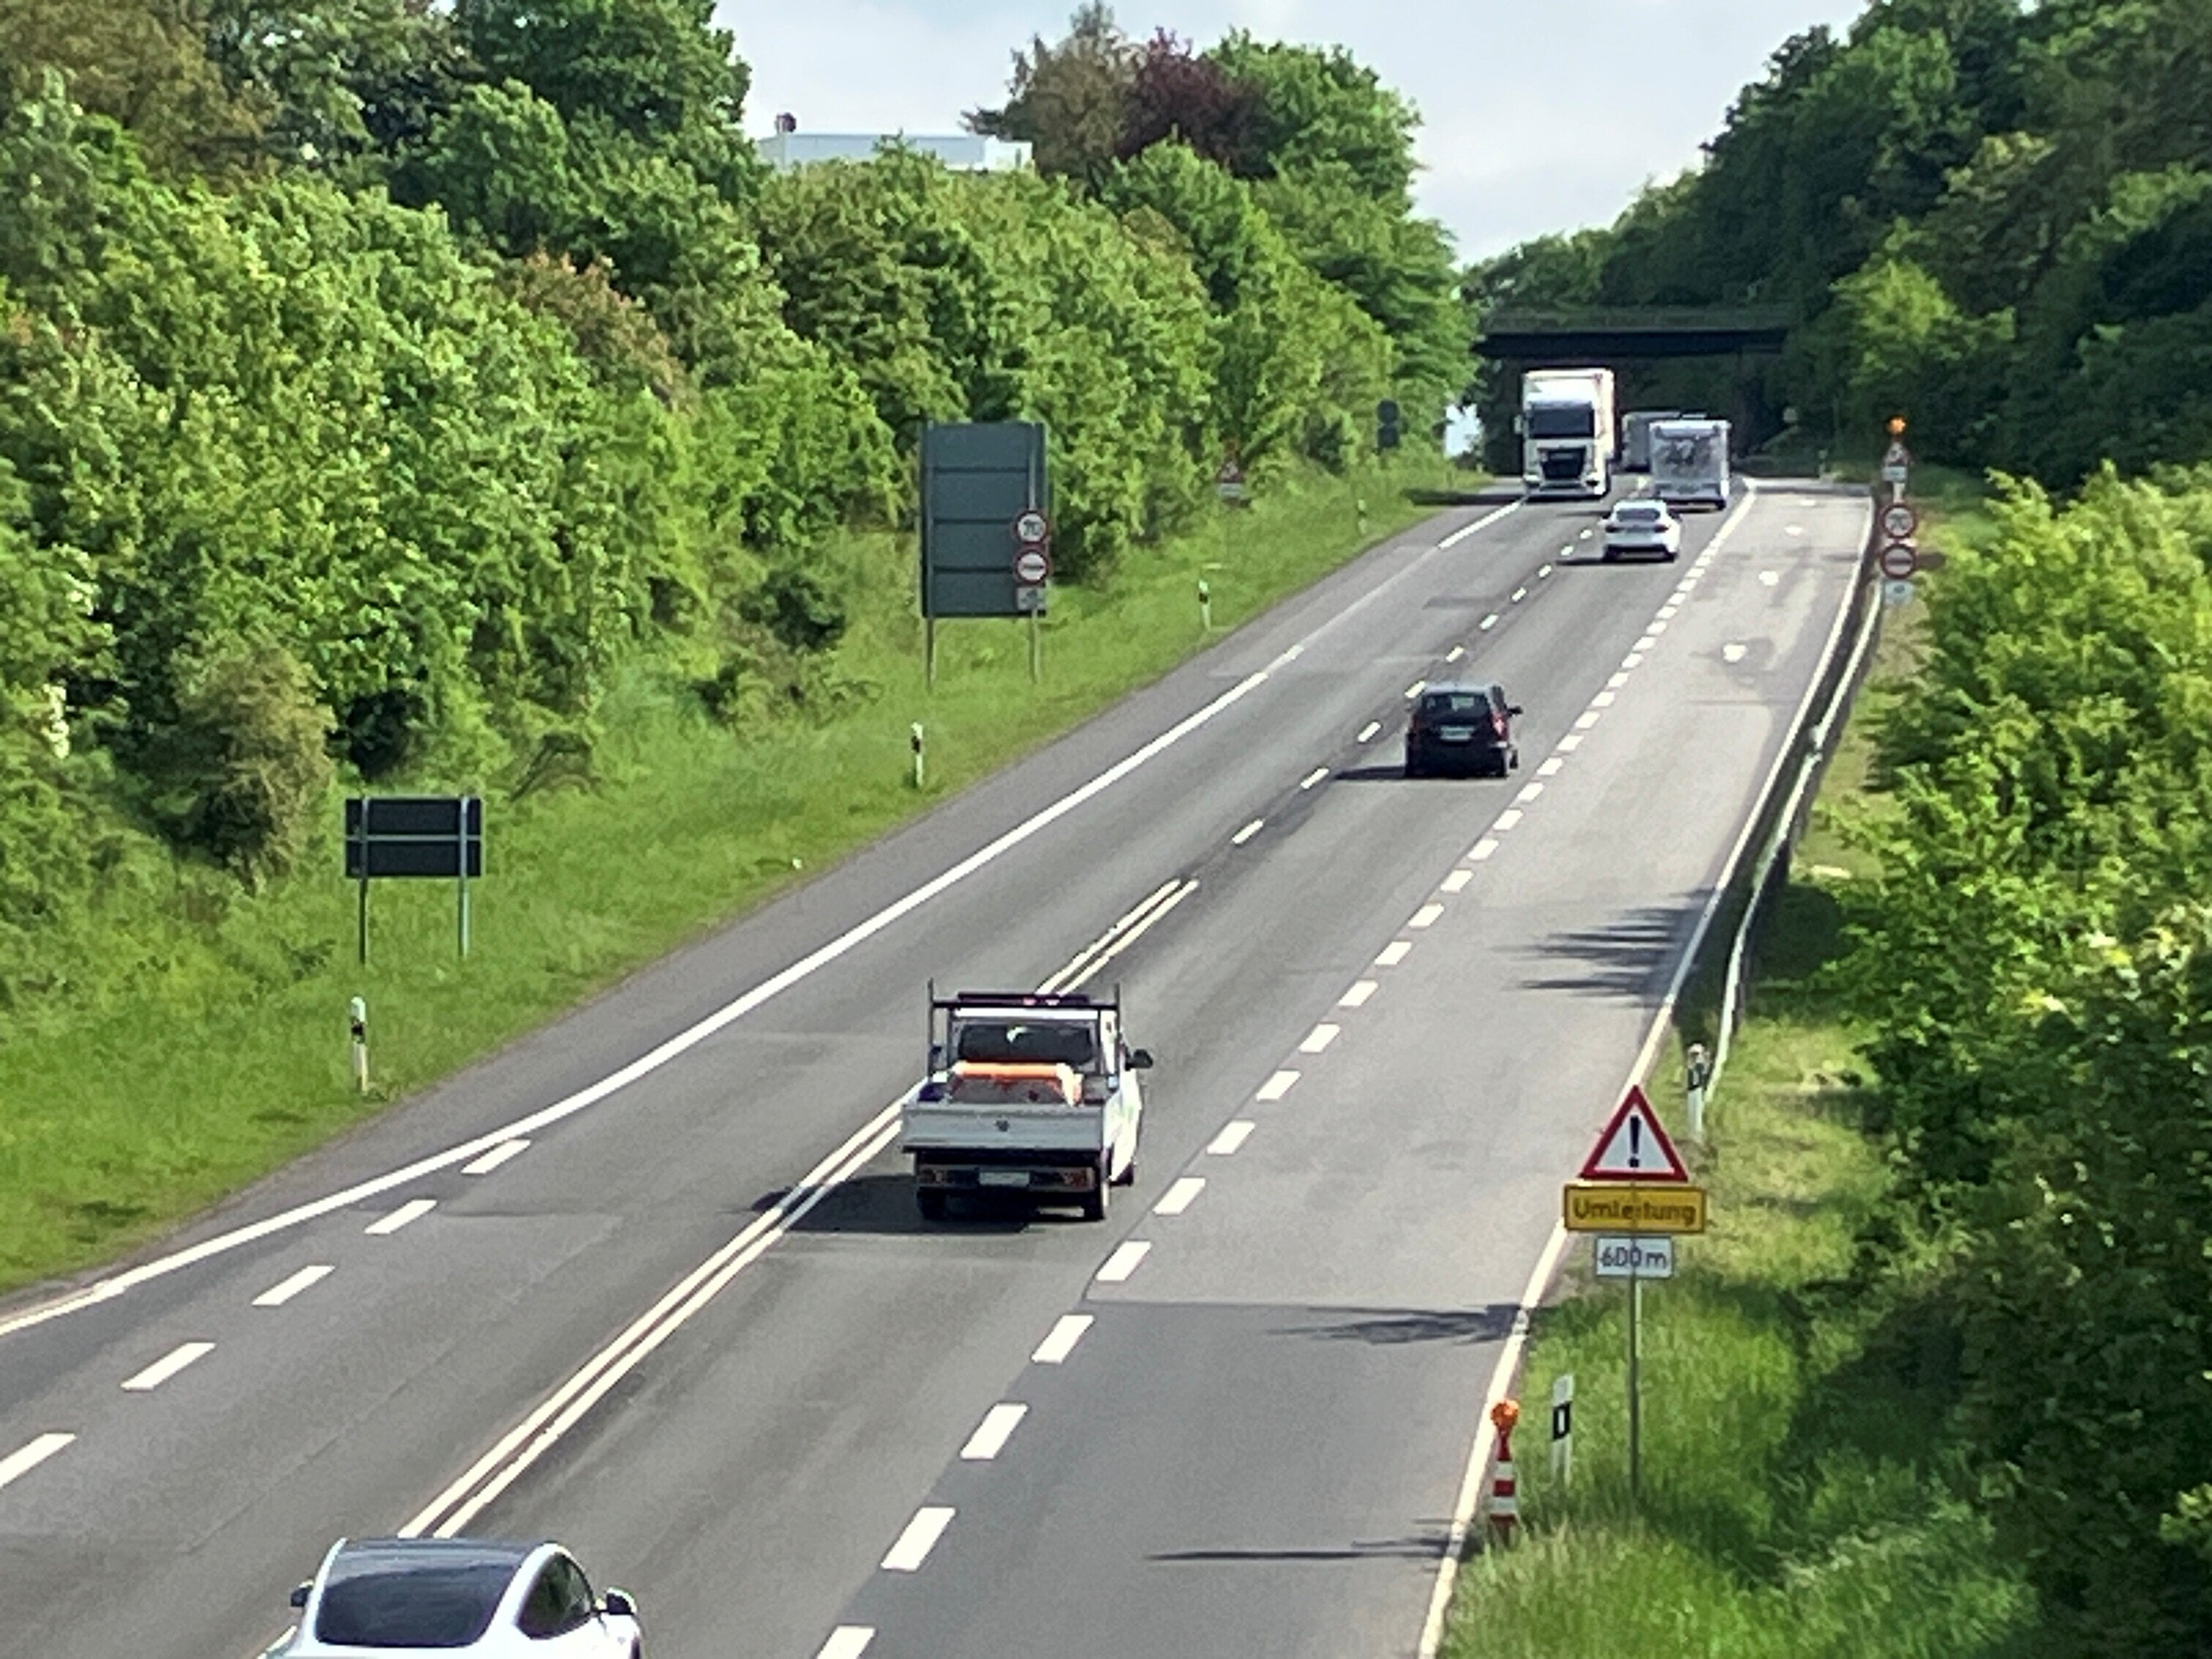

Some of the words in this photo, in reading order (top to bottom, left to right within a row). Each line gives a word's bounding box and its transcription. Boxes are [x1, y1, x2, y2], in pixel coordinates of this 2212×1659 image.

[1573, 1197, 1696, 1227] Umleitung
[1600, 1246, 1641, 1268] 600
[1646, 1252, 1667, 1269] m
